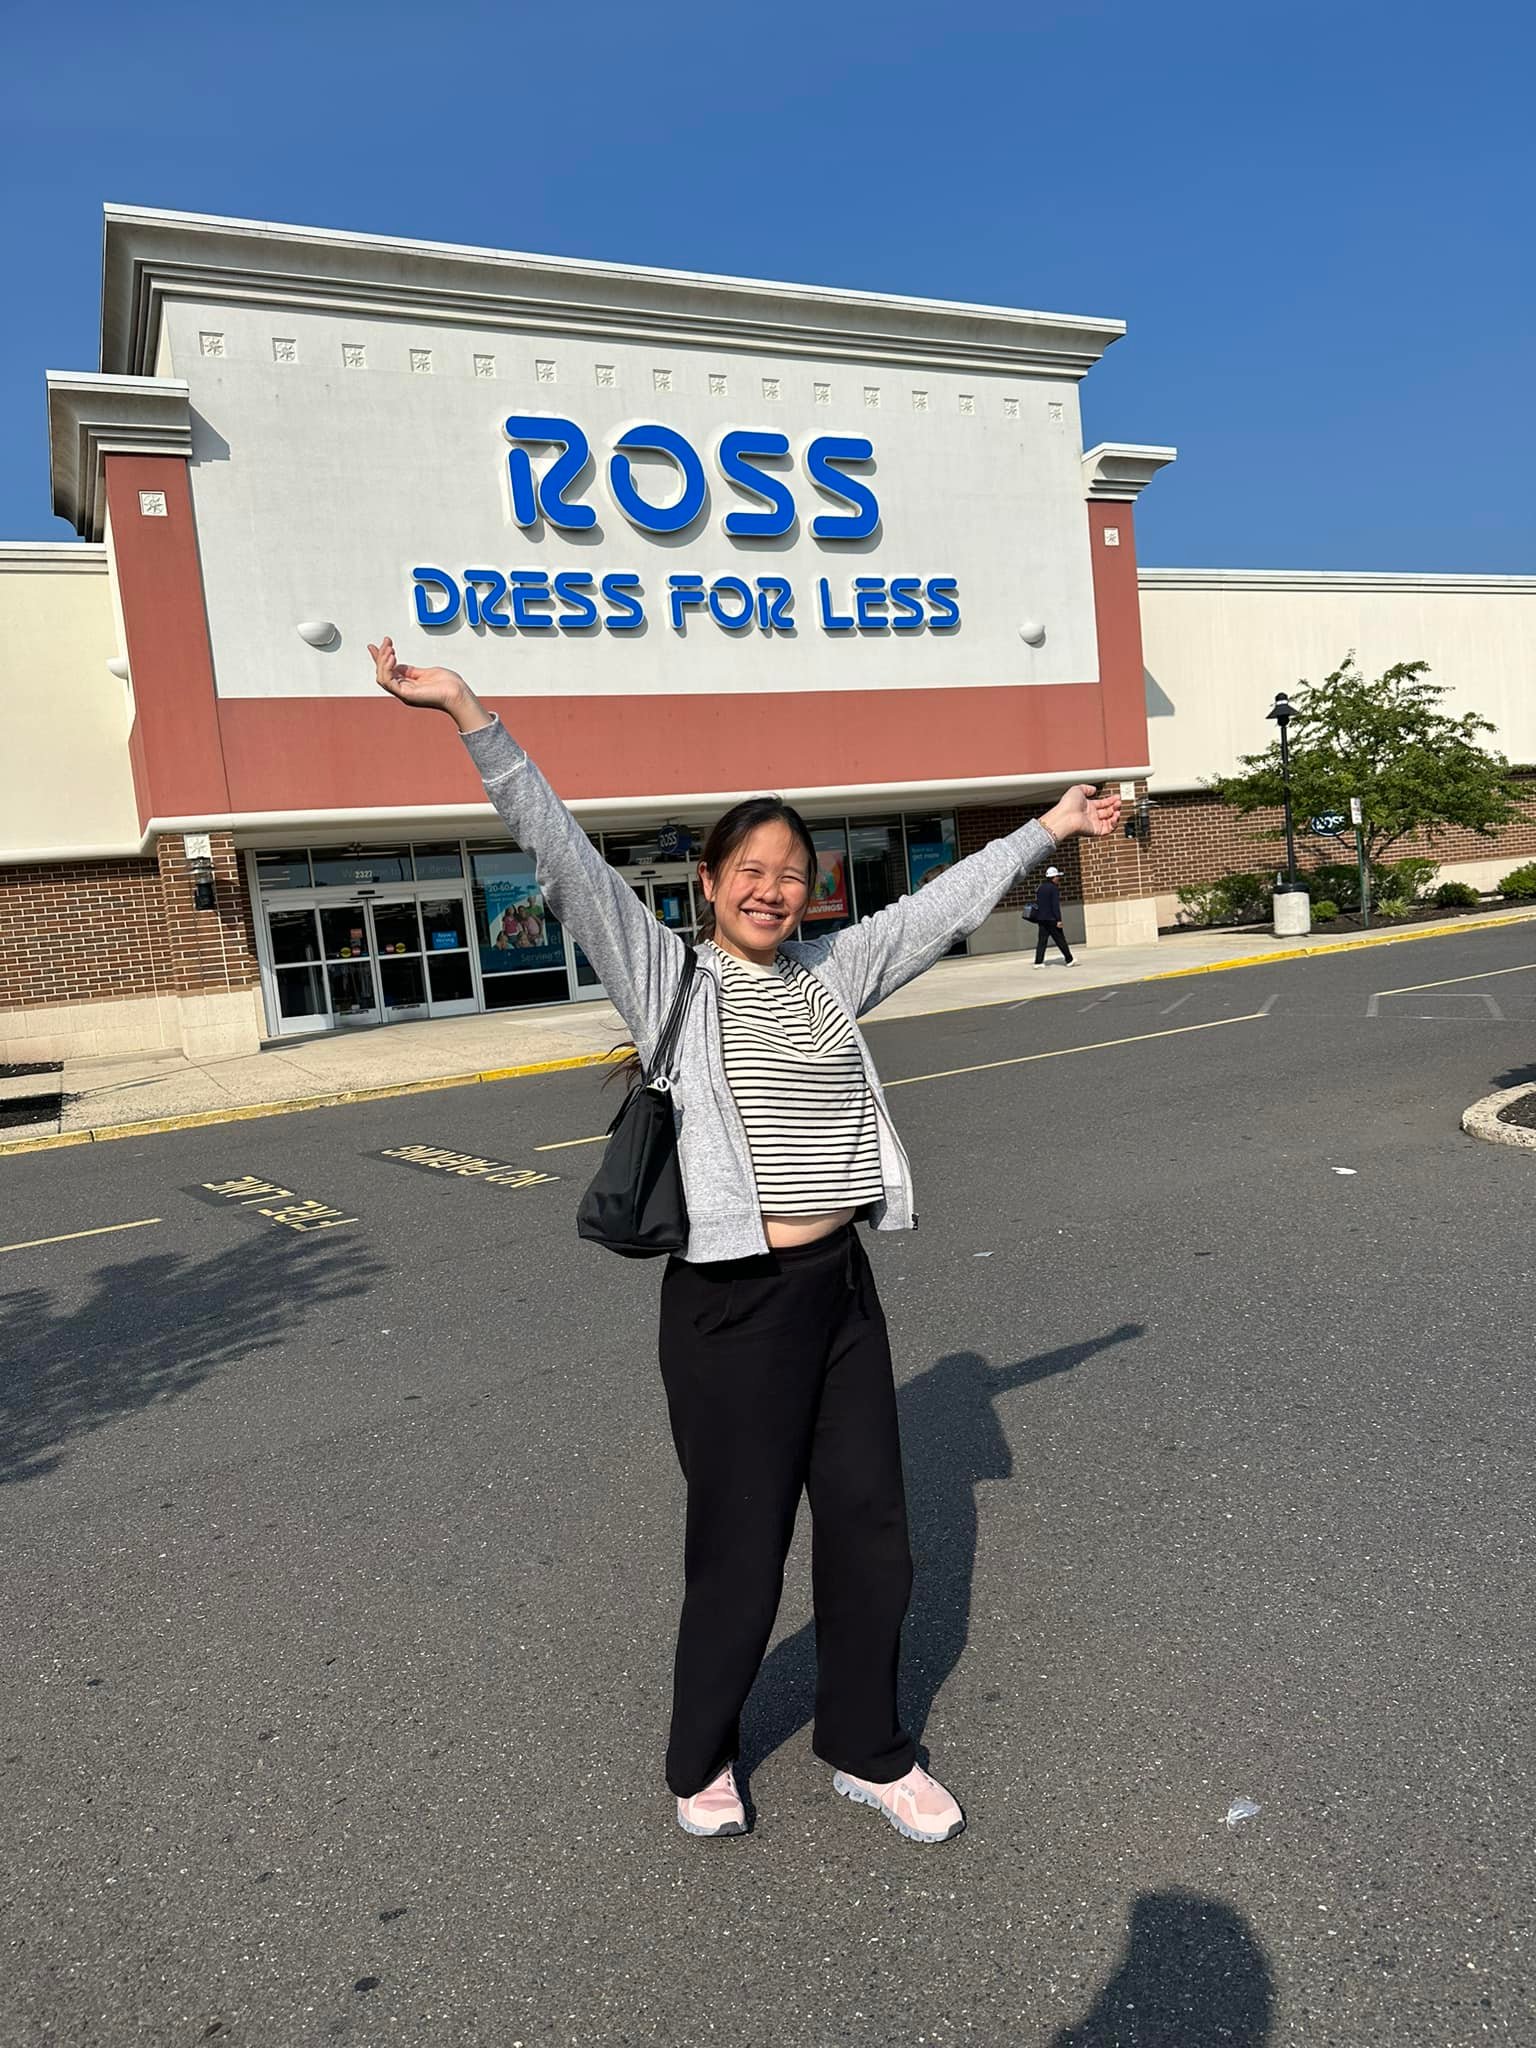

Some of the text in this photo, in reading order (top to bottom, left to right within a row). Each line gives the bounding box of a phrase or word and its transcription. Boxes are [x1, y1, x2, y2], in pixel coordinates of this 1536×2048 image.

[504, 416, 881, 539] ROSS
[412, 567, 961, 629] DRESS FOR LESS
[381, 1145, 561, 1188] NO PARKING
[201, 1175, 360, 1232] FIRE LANE
